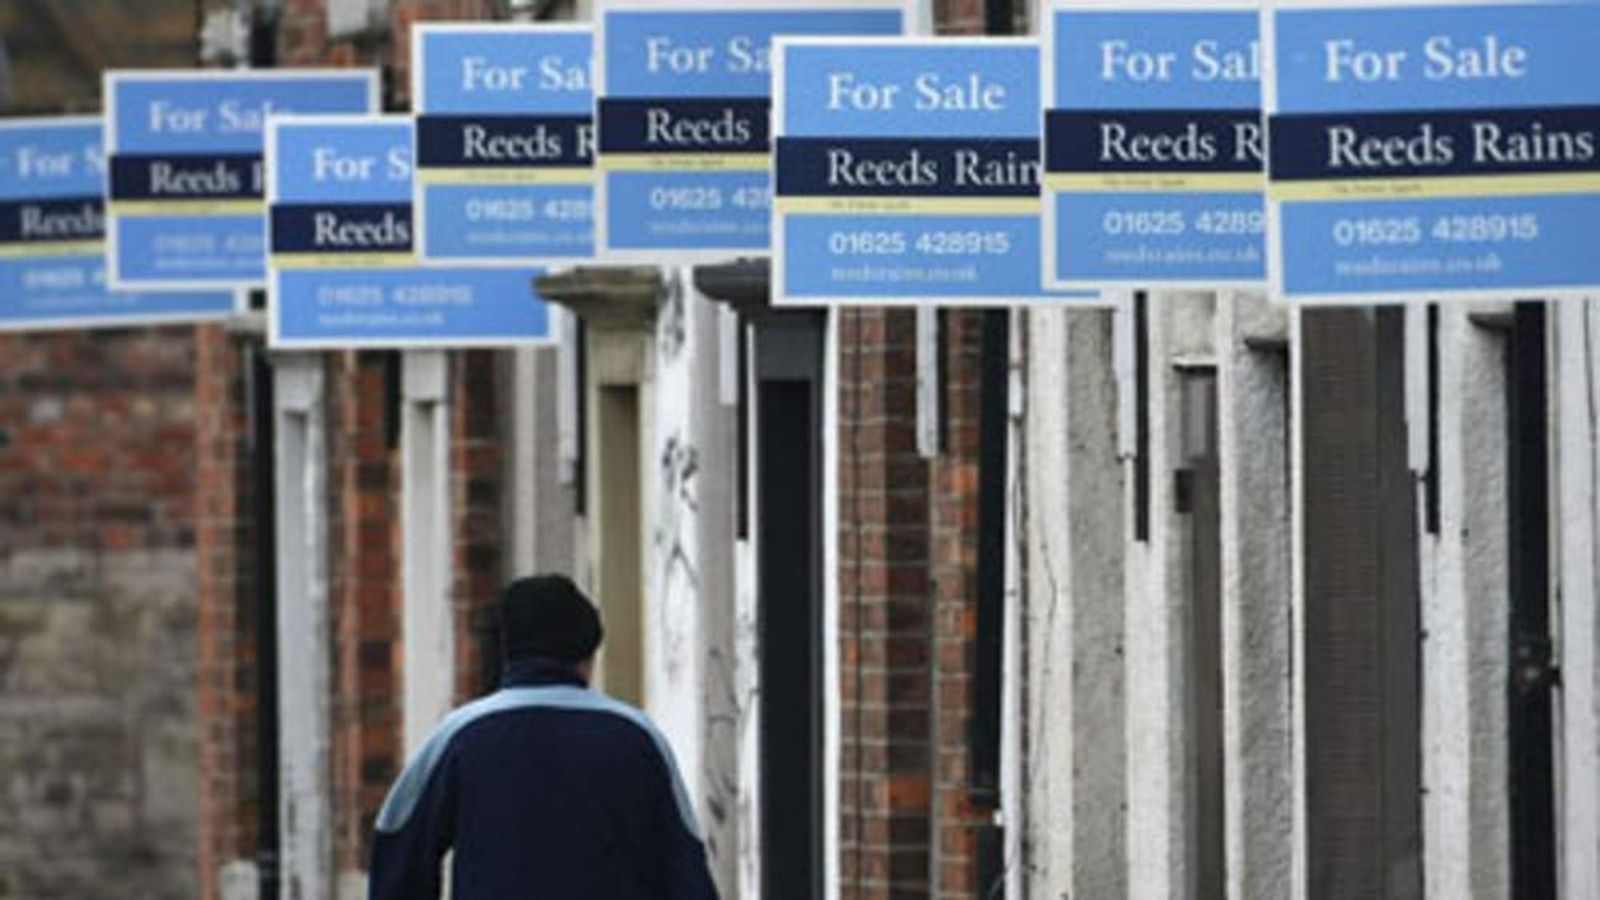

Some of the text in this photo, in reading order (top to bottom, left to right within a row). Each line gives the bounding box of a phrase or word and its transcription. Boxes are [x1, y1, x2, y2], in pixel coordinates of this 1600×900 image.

[645, 36, 714, 74] For
[1100, 40, 1176, 81] For
[1325, 35, 1527, 82] For Sale
[462, 56, 527, 91] For
[828, 72, 1006, 111] For Sale
[150, 101, 207, 133] For
[646, 108, 751, 143] Reeds
[462, 123, 562, 159] Reeds
[1100, 122, 1218, 163] Reeds
[1327, 122, 1595, 168] Reeds Rains
[17, 146, 74, 179] For
[150, 161, 243, 195] Reeds
[314, 148, 376, 181] For
[828, 148, 939, 187] Reeds
[313, 211, 411, 246] Reeds
[1104, 210, 1186, 235] 01625
[1332, 213, 1538, 247] 01625 428915
[915, 231, 1011, 254] 428915
